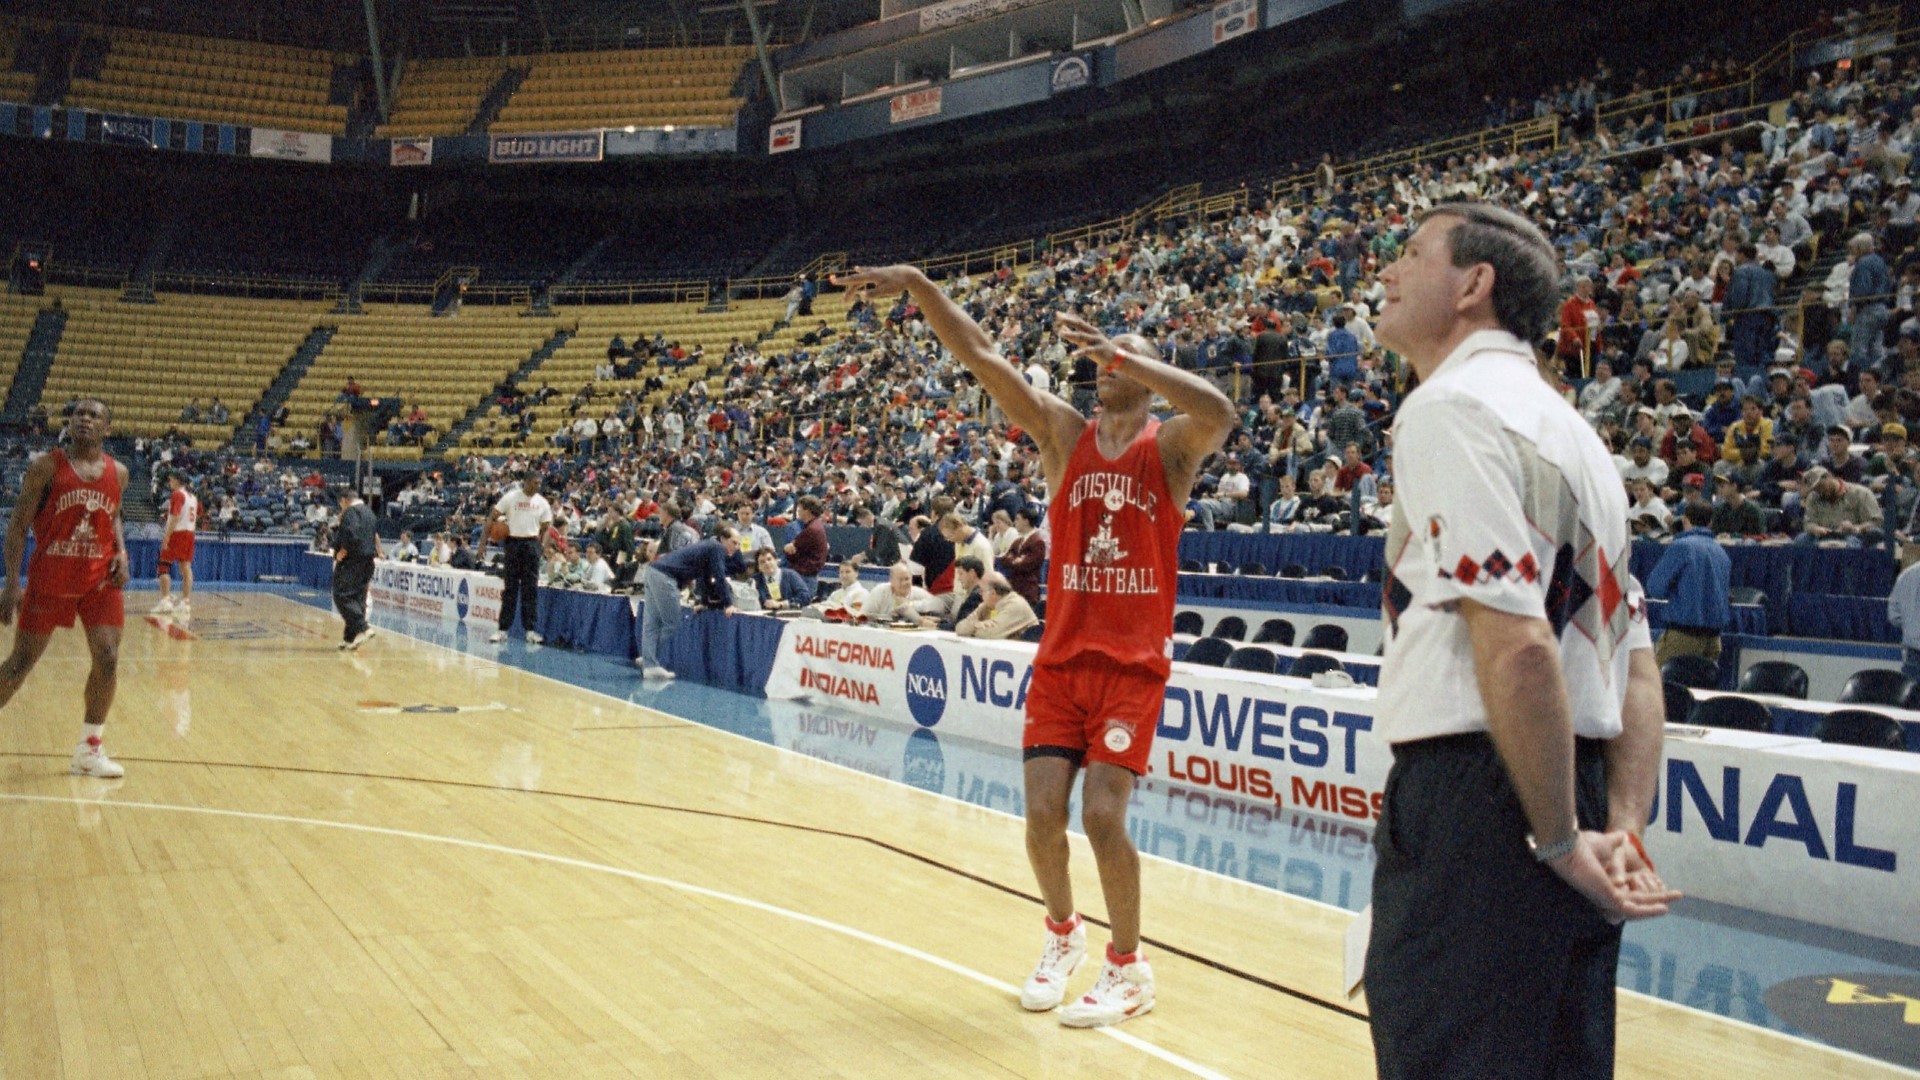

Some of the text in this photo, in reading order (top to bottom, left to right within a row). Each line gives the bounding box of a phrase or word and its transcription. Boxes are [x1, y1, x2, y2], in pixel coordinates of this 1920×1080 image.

[497, 139, 595, 155] BUD LIGHT
[382, 568, 414, 591] MIDWEST
[416, 573, 455, 600] REGIONAL
[908, 672, 947, 700] NCAA
[1156, 686, 1374, 774] DWEST
[1168, 751, 1283, 808] LOUIS,
